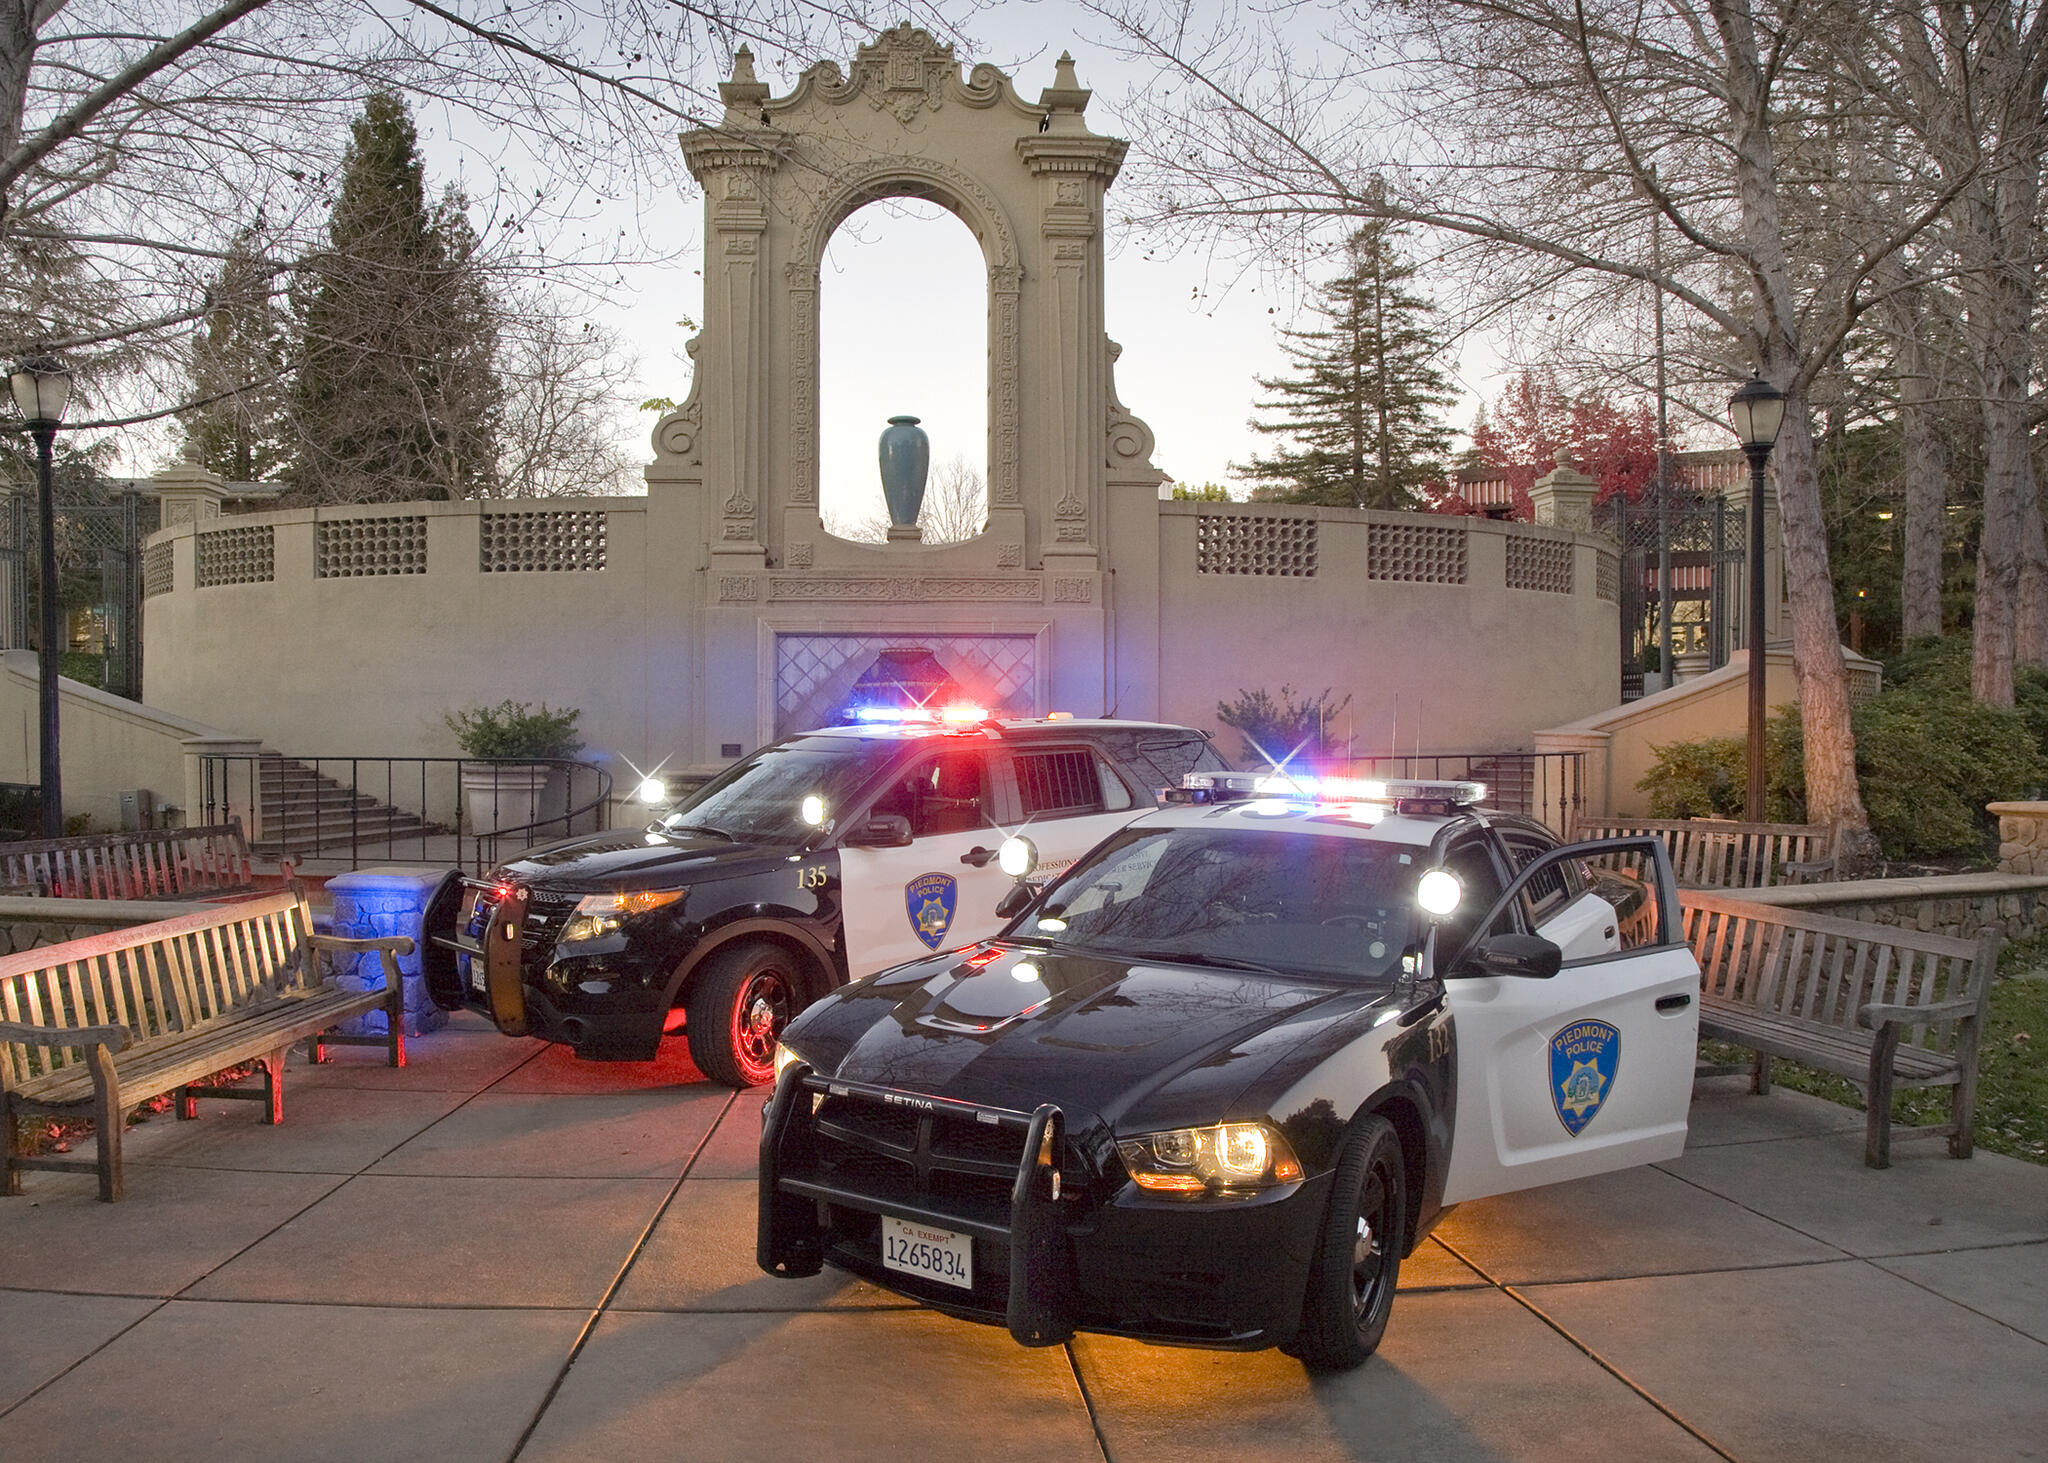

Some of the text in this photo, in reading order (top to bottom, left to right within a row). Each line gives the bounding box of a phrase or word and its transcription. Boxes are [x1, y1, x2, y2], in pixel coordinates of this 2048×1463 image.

[796, 866, 827, 889] 135
[909, 876, 952, 893] PIEDMONT
[917, 885, 945, 898] POLICE
[1427, 1023, 1449, 1064] 132
[1555, 1025, 1614, 1051] PIEDMONT
[1565, 1040, 1605, 1059] POLICE
[884, 1094, 934, 1111] SETINA
[902, 1226, 950, 1245] CA EXEMPT
[887, 1235, 966, 1280] 1265834
